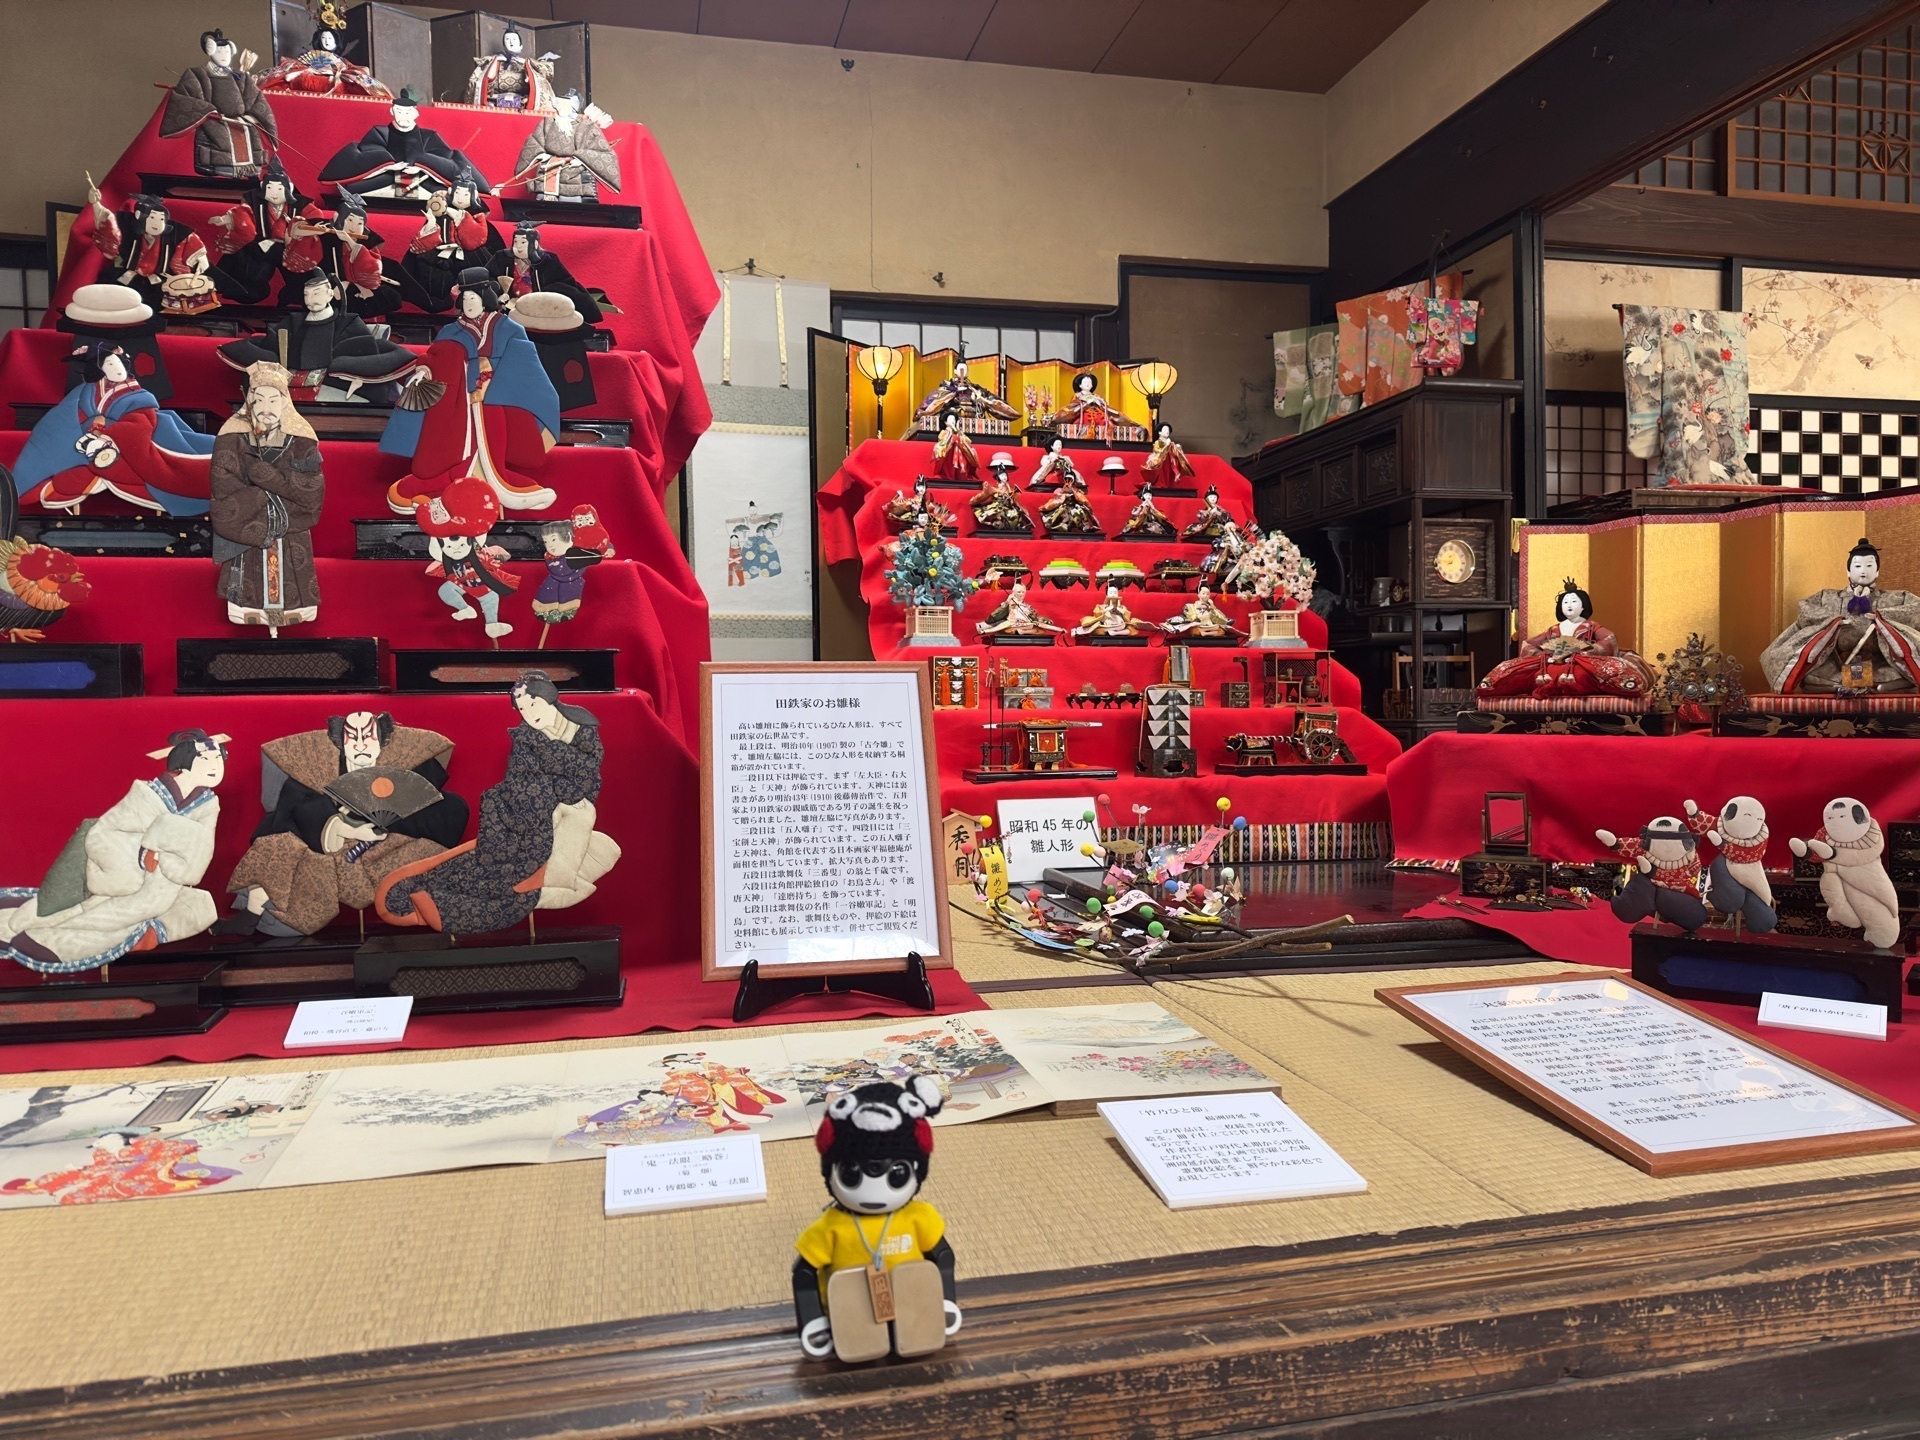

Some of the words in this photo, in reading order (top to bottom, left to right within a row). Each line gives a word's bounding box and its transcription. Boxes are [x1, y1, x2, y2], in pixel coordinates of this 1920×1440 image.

[776, 698, 861, 708] 田鉄家のお雛様
[738, 721, 902, 730] 高い雛壇に飾られているひな人形は、すべて
[730, 732, 809, 740] 田鉄家の伝世品です。
[731, 763, 806, 771] 箱が置かれています。
[1031, 839, 1074, 853] 雛人形
[735, 940, 756, 949] さい。
